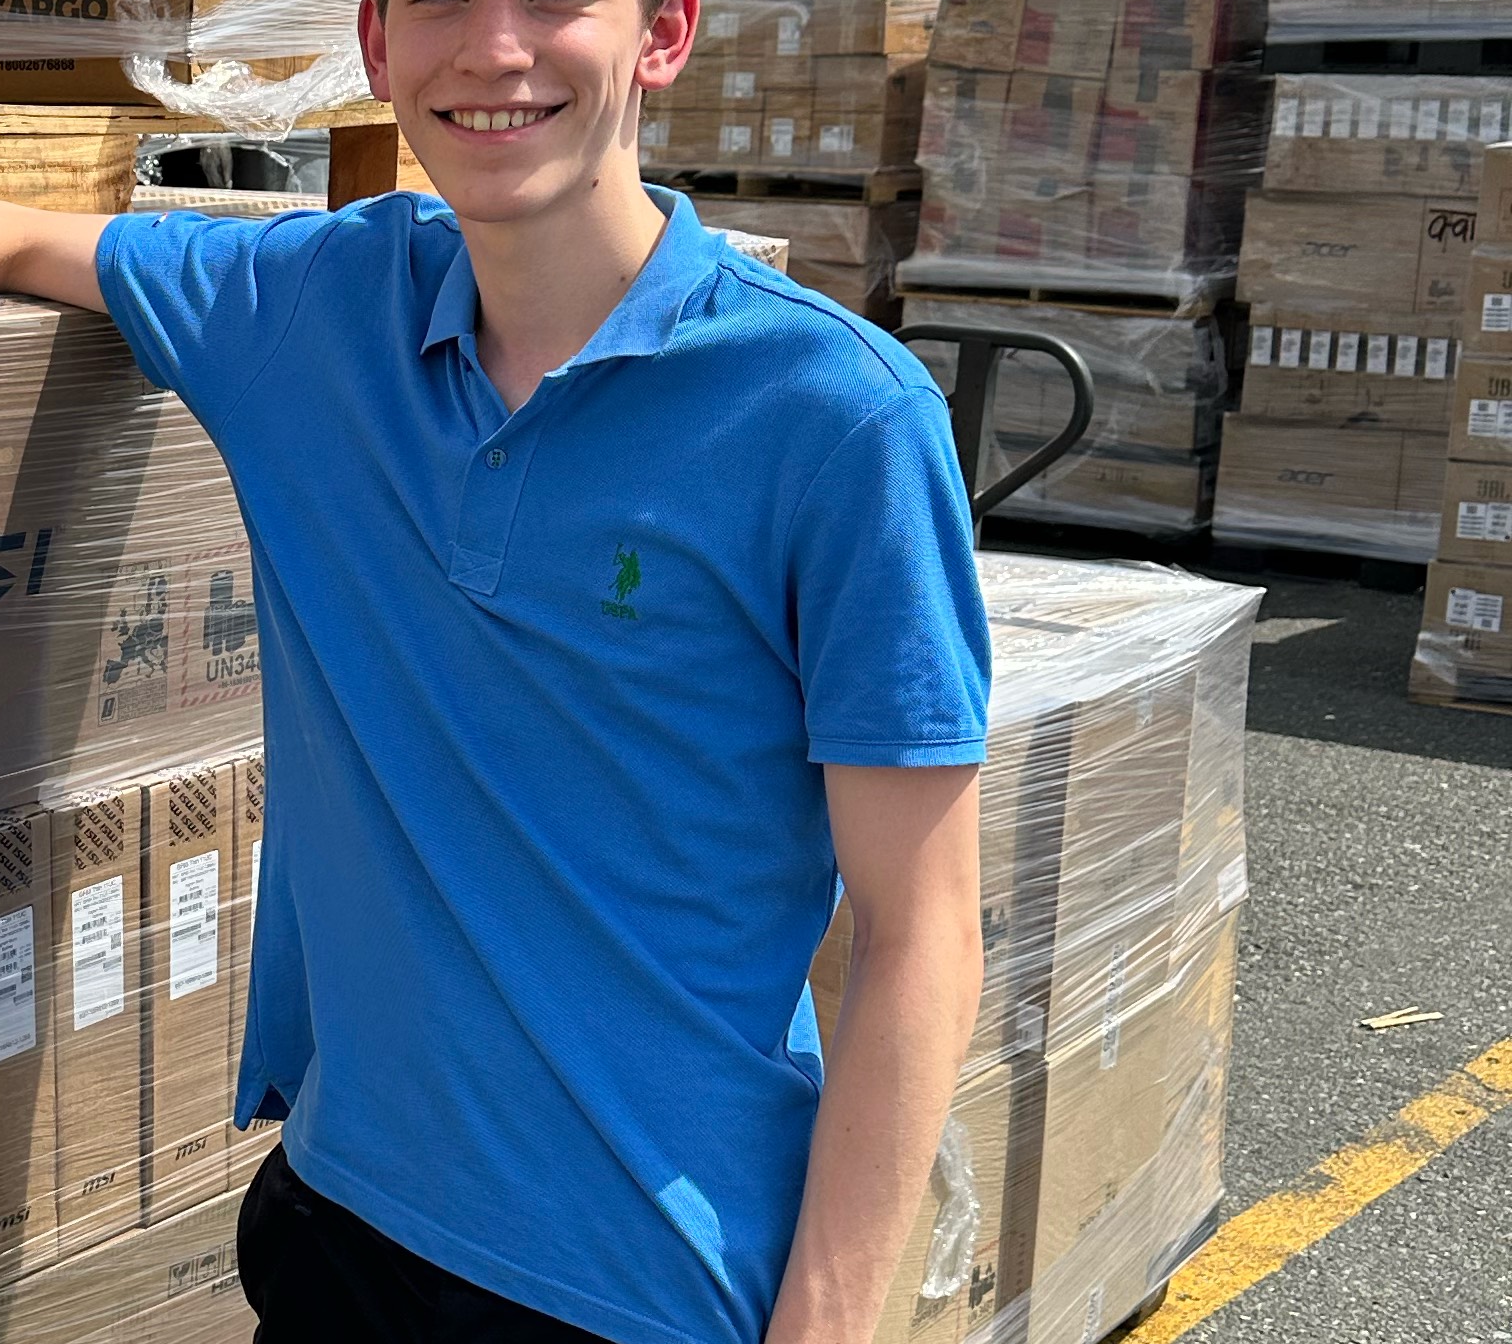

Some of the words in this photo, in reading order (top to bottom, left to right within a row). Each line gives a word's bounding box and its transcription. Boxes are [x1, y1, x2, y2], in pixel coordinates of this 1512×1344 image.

[205, 650, 262, 683] UN34
[175, 1137, 207, 1160] msi
[82, 1171, 115, 1196] msi
